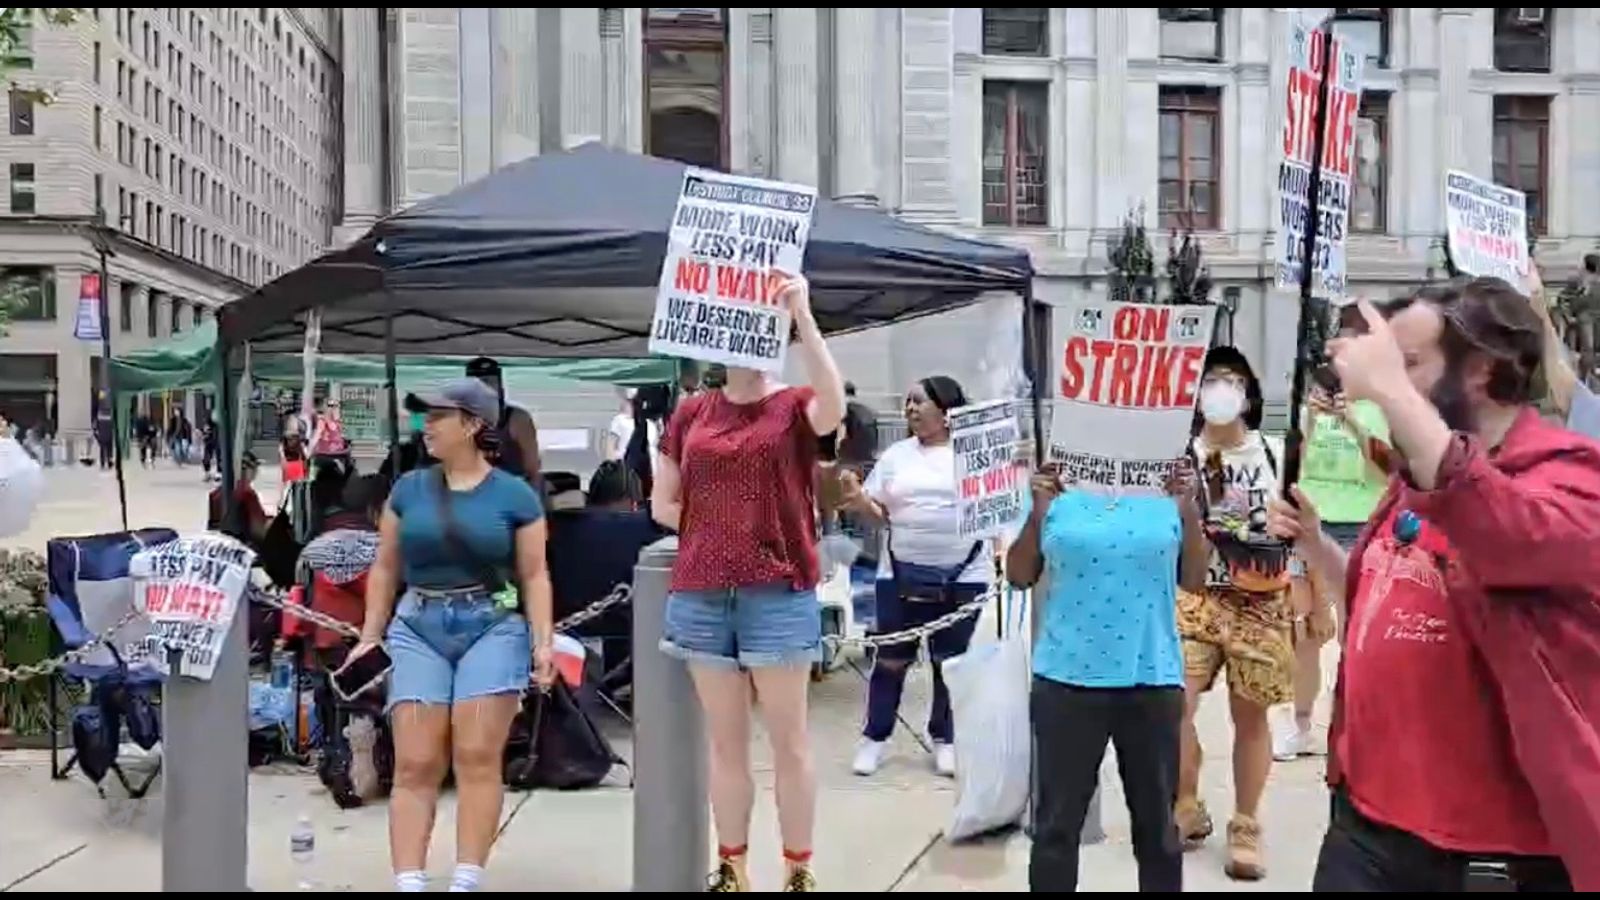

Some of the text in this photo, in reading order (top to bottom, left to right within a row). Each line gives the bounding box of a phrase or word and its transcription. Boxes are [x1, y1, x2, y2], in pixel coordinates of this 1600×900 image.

[1284, 66, 1358, 173] STRKE
[676, 205, 735, 233] MORE
[1281, 197, 1344, 241] WORERS
[691, 231, 780, 267] LESS PAY
[674, 258, 710, 295] NO
[668, 298, 778, 336] WE DESERVE A
[1114, 306, 1170, 342] ON
[655, 319, 727, 348] LIVEABLE
[1061, 336, 1205, 407] STRIKE
[966, 448, 990, 472] LESS
[1051, 446, 1116, 470] MUNICIPAL
[1121, 460, 1177, 474] WORKER
[962, 475, 980, 498] NO
[1058, 462, 1116, 486] FSCME
[1121, 473, 1151, 487] D.C.
[151, 555, 228, 586] LESS PAY
